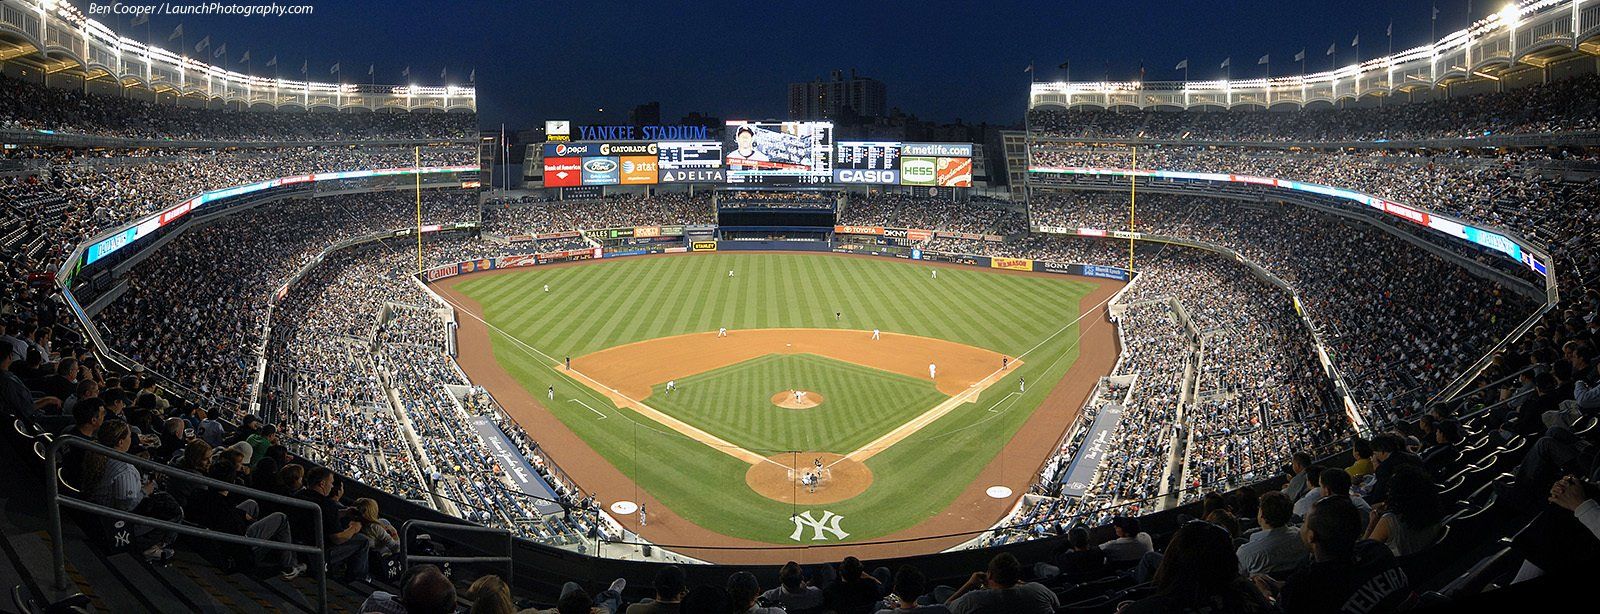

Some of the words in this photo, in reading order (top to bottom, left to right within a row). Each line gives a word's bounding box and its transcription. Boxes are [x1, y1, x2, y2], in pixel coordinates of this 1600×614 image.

[578, 125, 635, 140] YANKEE
[642, 125, 708, 140] STADIUM
[567, 145, 588, 154] pepsi
[611, 145, 647, 153] GATORADE
[912, 144, 970, 155] metlife.com
[591, 161, 610, 171] Ford
[636, 162, 656, 172] at&t
[904, 166, 933, 176] HESS
[677, 171, 723, 180] DELTA
[839, 170, 895, 183] CASIO
[588, 230, 608, 238] ZALES
[884, 229, 907, 237] DKNY
[428, 265, 458, 280] Canon
[789, 510, 850, 541] NY
[1341, 566, 1409, 614] TEIXEIRA
